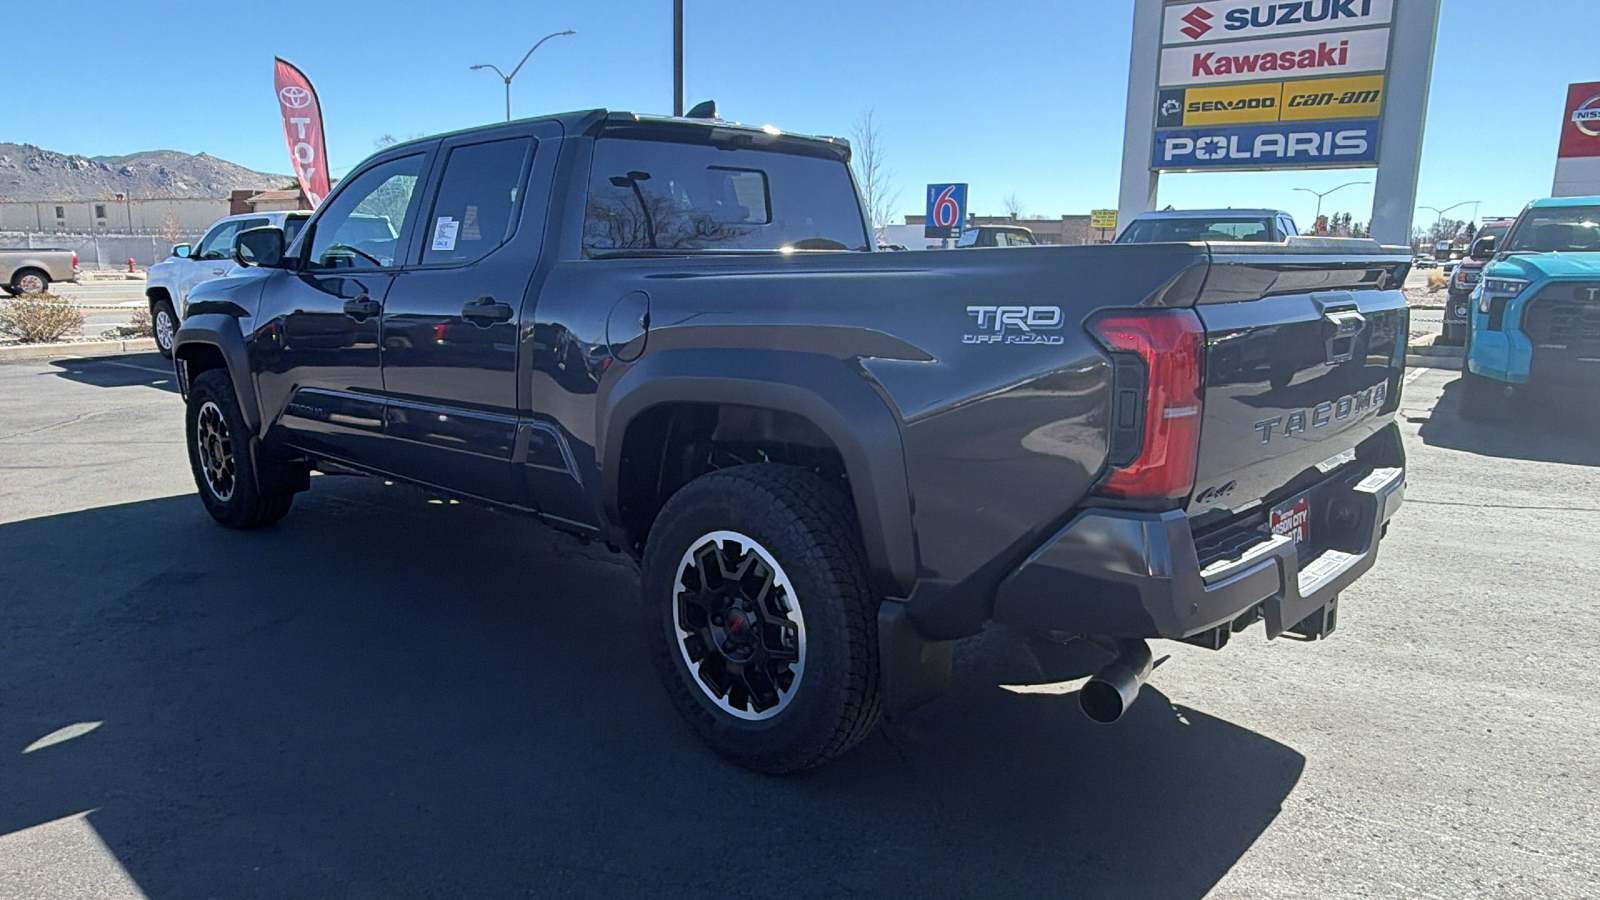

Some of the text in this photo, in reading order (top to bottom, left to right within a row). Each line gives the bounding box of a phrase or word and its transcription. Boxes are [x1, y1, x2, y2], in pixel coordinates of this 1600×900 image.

[1224, 0, 1371, 30] SUZUKI
[1192, 40, 1349, 77] Kawasaki
[1577, 111, 1600, 119] NIS
[1164, 129, 1368, 161] POLARIS
[934, 185, 959, 227] 6
[966, 306, 1063, 334] TRD
[962, 334, 1065, 345] OFF ROAD
[1254, 378, 1389, 444] TACOMA
[1292, 509, 1307, 527] CITY
